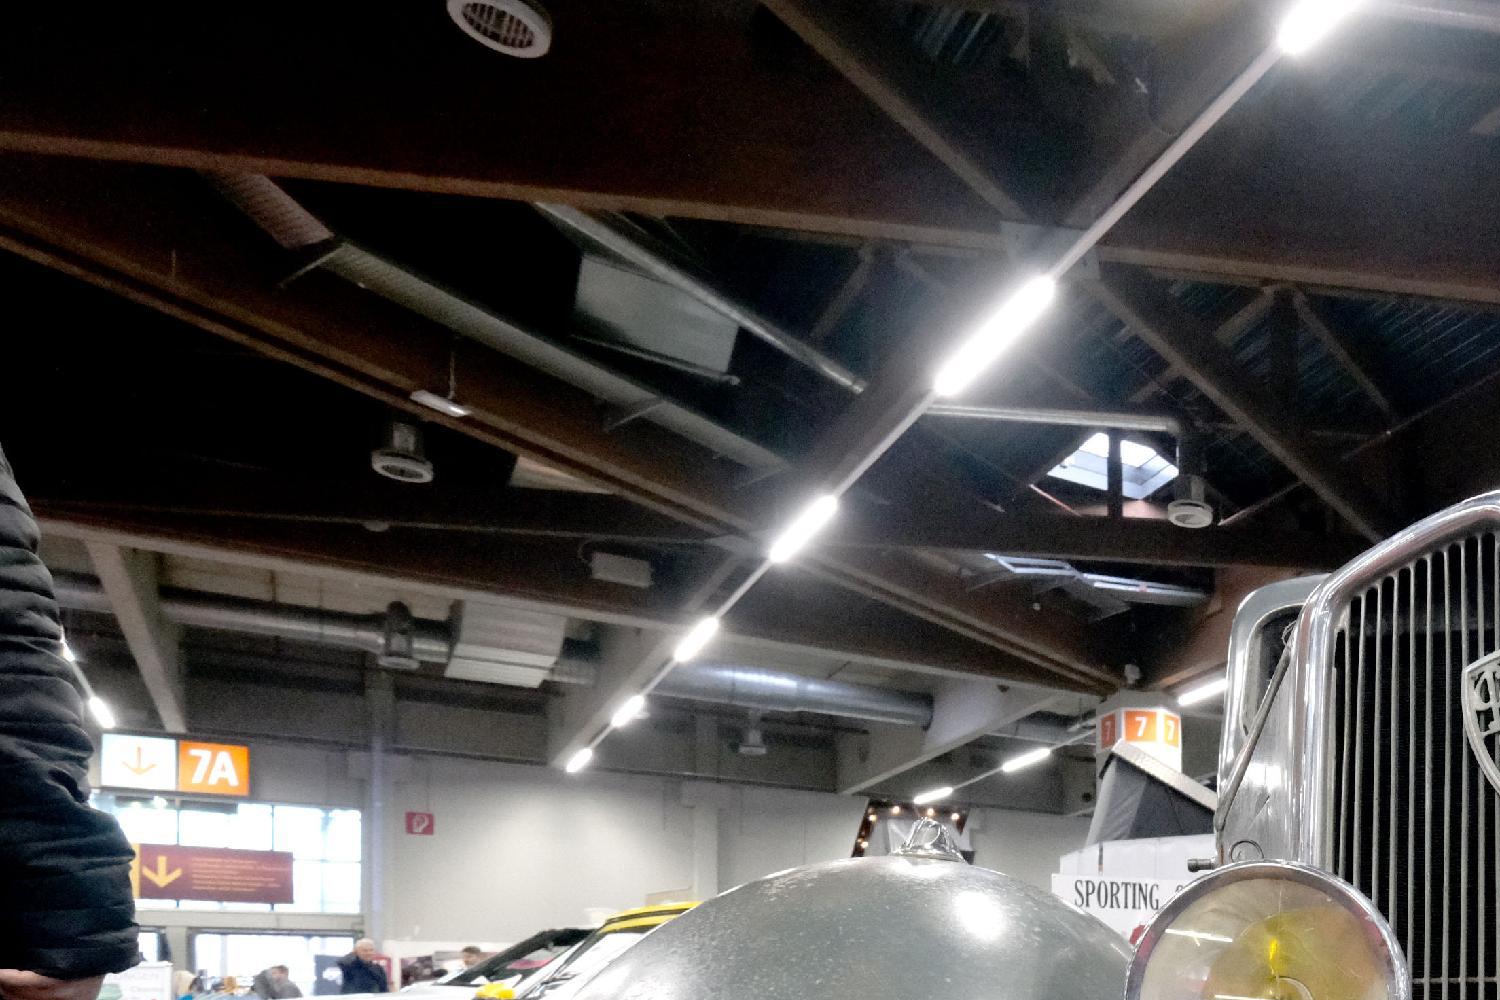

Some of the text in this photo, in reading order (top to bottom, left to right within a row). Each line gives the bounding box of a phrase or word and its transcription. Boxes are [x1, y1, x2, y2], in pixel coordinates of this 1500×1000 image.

[1135, 716, 1148, 737] 7
[1166, 720, 1175, 741] 7
[189, 749, 239, 786] 7A
[1074, 879, 1159, 910] SPORTING
